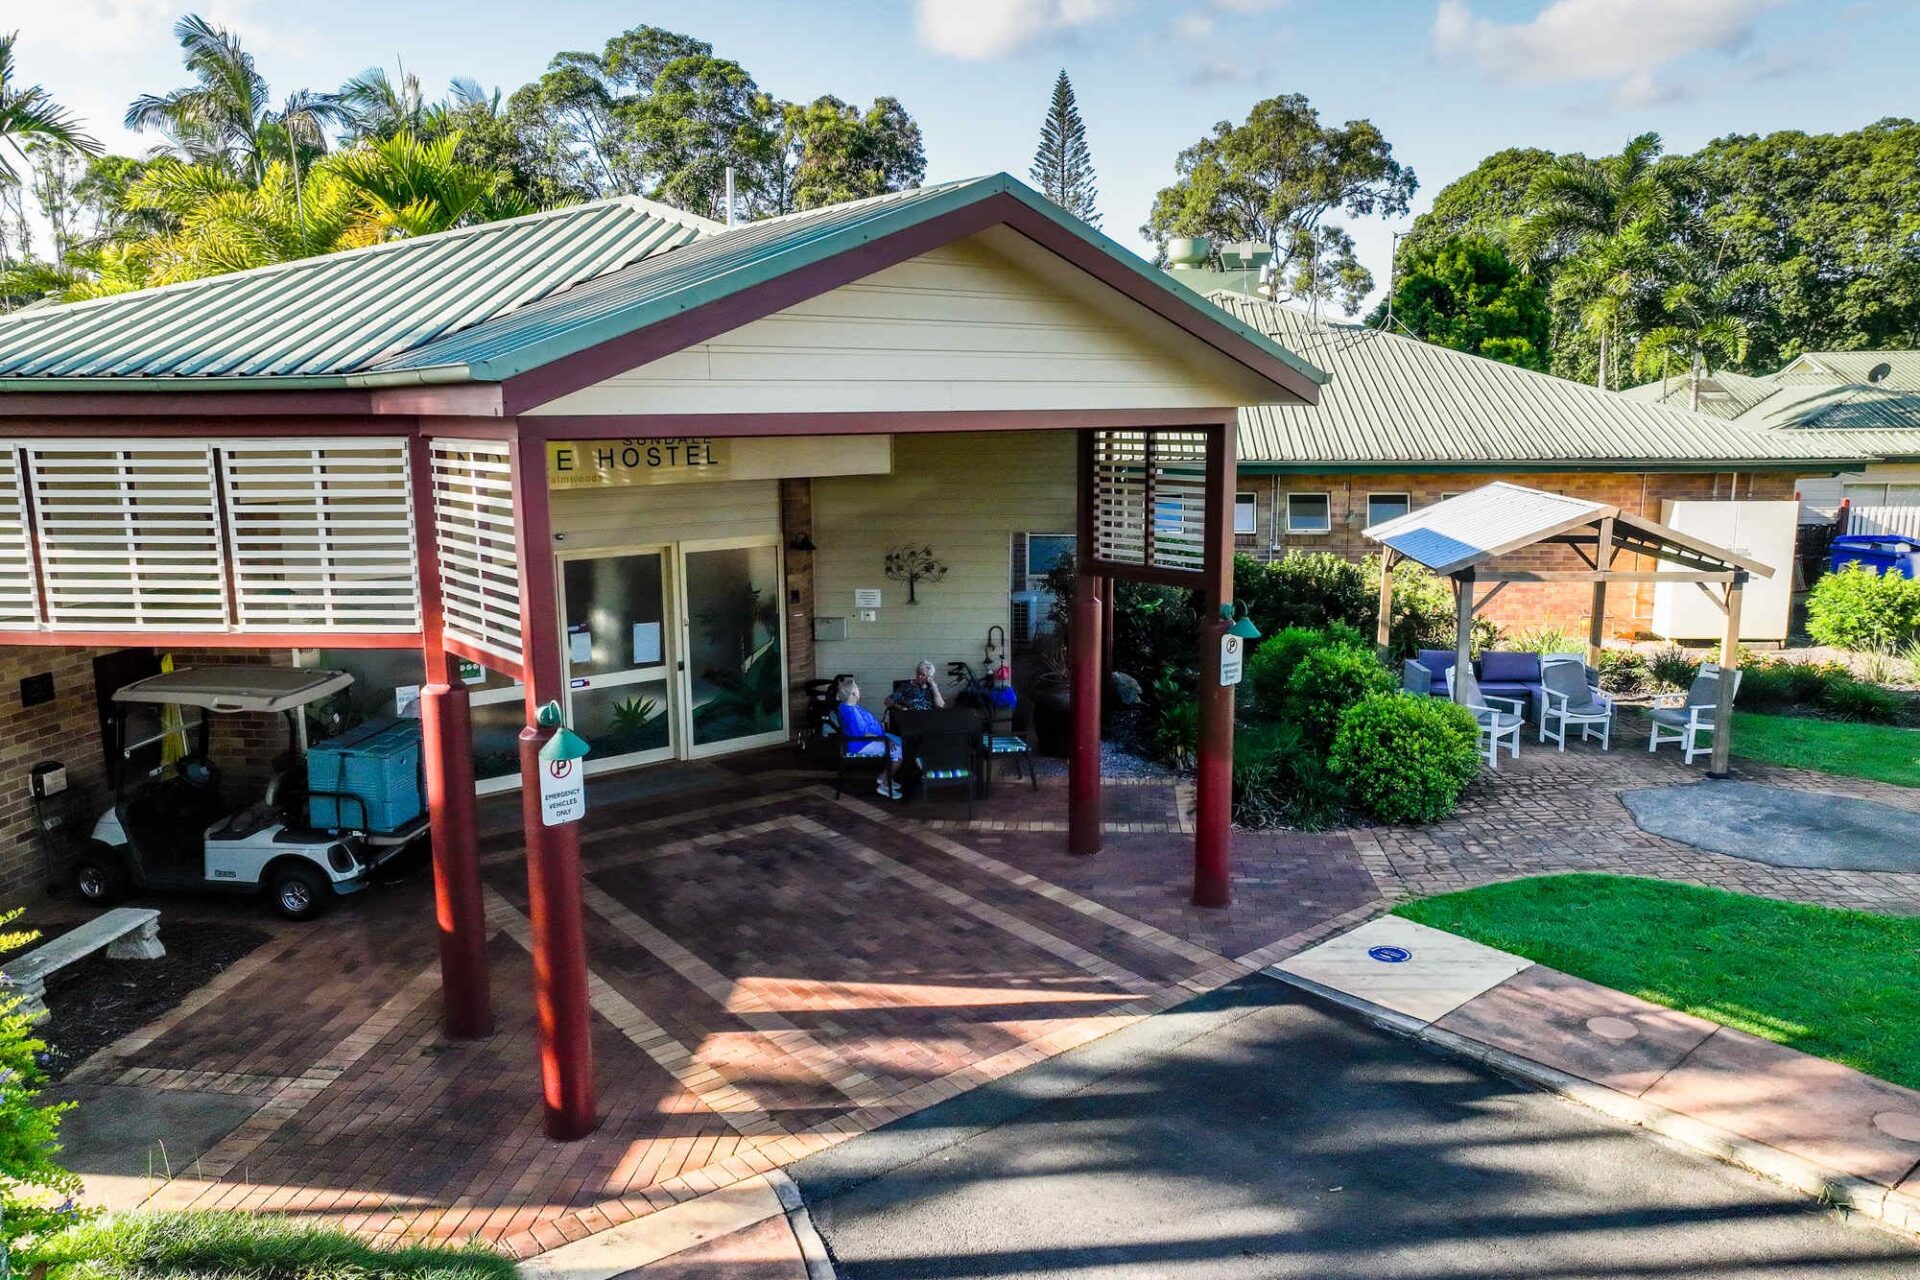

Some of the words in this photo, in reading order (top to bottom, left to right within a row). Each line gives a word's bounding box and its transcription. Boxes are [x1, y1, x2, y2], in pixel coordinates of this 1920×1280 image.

[598, 445, 719, 469] HOSTEL
[545, 789, 580, 800] EMERGENCY
[549, 798, 578, 809] VEHICLES
[556, 809, 571, 817] ONLY
